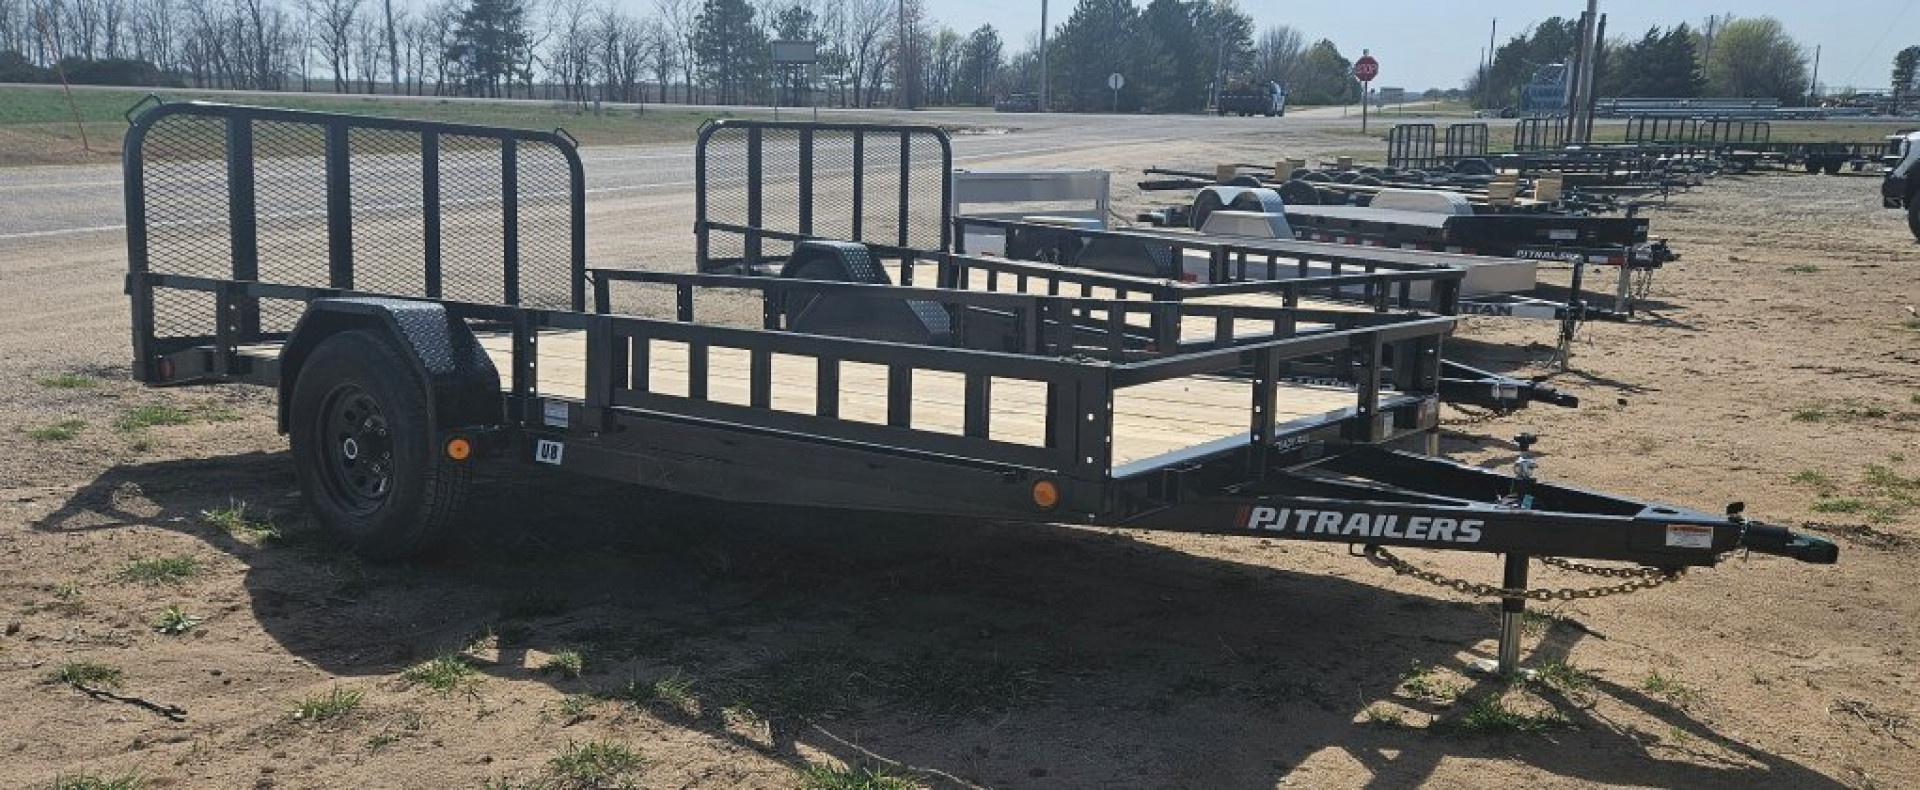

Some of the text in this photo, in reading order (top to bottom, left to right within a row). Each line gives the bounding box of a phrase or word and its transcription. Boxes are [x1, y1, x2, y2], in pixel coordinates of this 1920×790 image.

[1356, 63, 1377, 73] STOP
[1248, 506, 1485, 543] PJ TRAILERS
